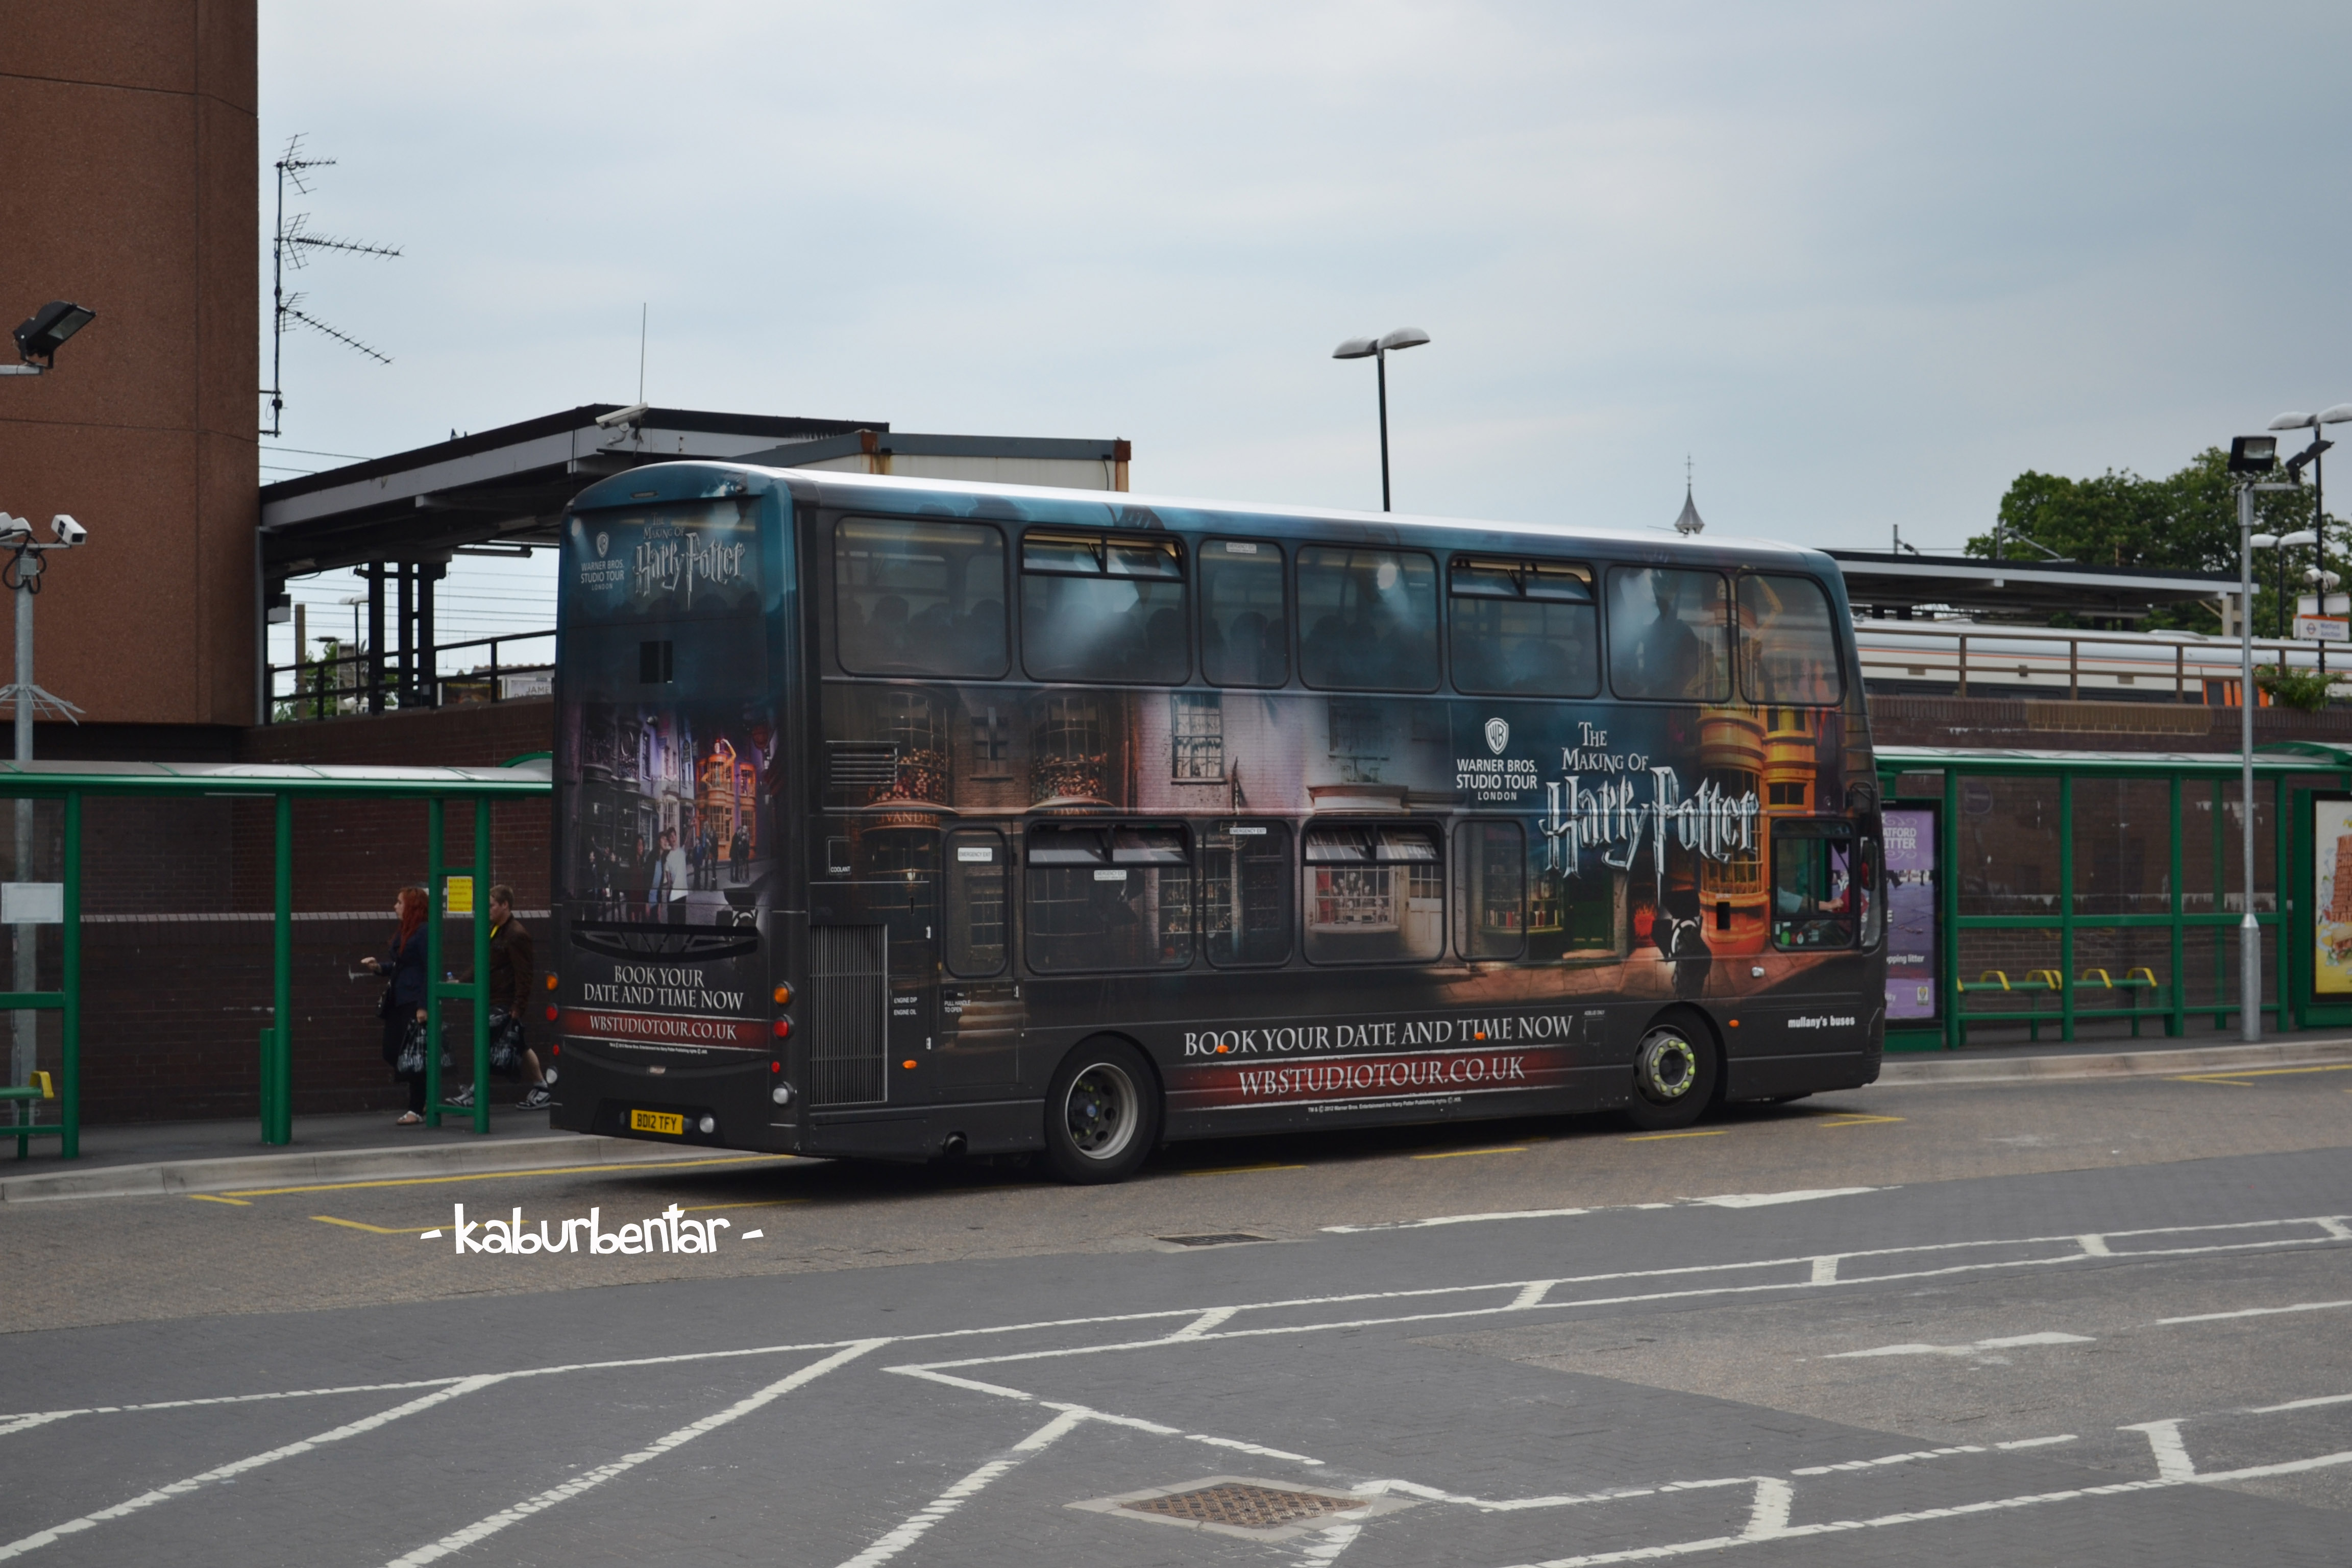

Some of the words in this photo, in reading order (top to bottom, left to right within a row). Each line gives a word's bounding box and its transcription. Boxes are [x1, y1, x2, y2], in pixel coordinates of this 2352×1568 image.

[643, 526, 672, 540] MAKING
[581, 560, 606, 571] WARNER
[607, 559, 624, 569] BROS.
[632, 540, 685, 598] Harry
[685, 531, 745, 611] Potter
[580, 571, 604, 584] STUDIO
[606, 569, 624, 581] TOUR
[592, 582, 613, 591] LONDON
[1578, 721, 1607, 747] THE
[1456, 758, 1504, 772] WARNER
[1507, 760, 1538, 773] BROS.
[1562, 747, 1624, 774] MAKING
[1628, 753, 1649, 771] OF
[1456, 774, 1502, 789] STUDIO
[1504, 774, 1538, 790] TOUR
[1477, 791, 1517, 801] LONDON
[1538, 775, 1649, 879] Harry
[1649, 767, 1759, 908] Potter
[1883, 827, 1917, 838] ATFORD
[1884, 838, 1917, 849] ITTER
[1907, 953, 1925, 963] litter
[615, 965, 657, 986] BOOK
[659, 967, 704, 988] YOUR
[584, 983, 619, 1003] DATE
[621, 986, 654, 1004] AND
[657, 987, 696, 1008] TIME
[701, 990, 744, 1011] NOW
[590, 1015, 737, 1040] WBSTUDIOTOUR.CO.UK
[1788, 1015, 1828, 1029] mullany's
[1830, 1015, 1855, 1026] buses
[1184, 1029, 1258, 1056] BOOK
[1262, 1025, 1331, 1052] YOUR
[1335, 1022, 1396, 1048] DATE
[1401, 1020, 1452, 1045] AND
[1457, 1016, 1512, 1042] TIME
[1517, 1015, 1574, 1039] NOW
[1238, 1056, 1525, 1096] WBSTUDIOTOUR.CO.UK
[636, 1113, 656, 1129] BD12
[658, 1115, 677, 1131] TFY
